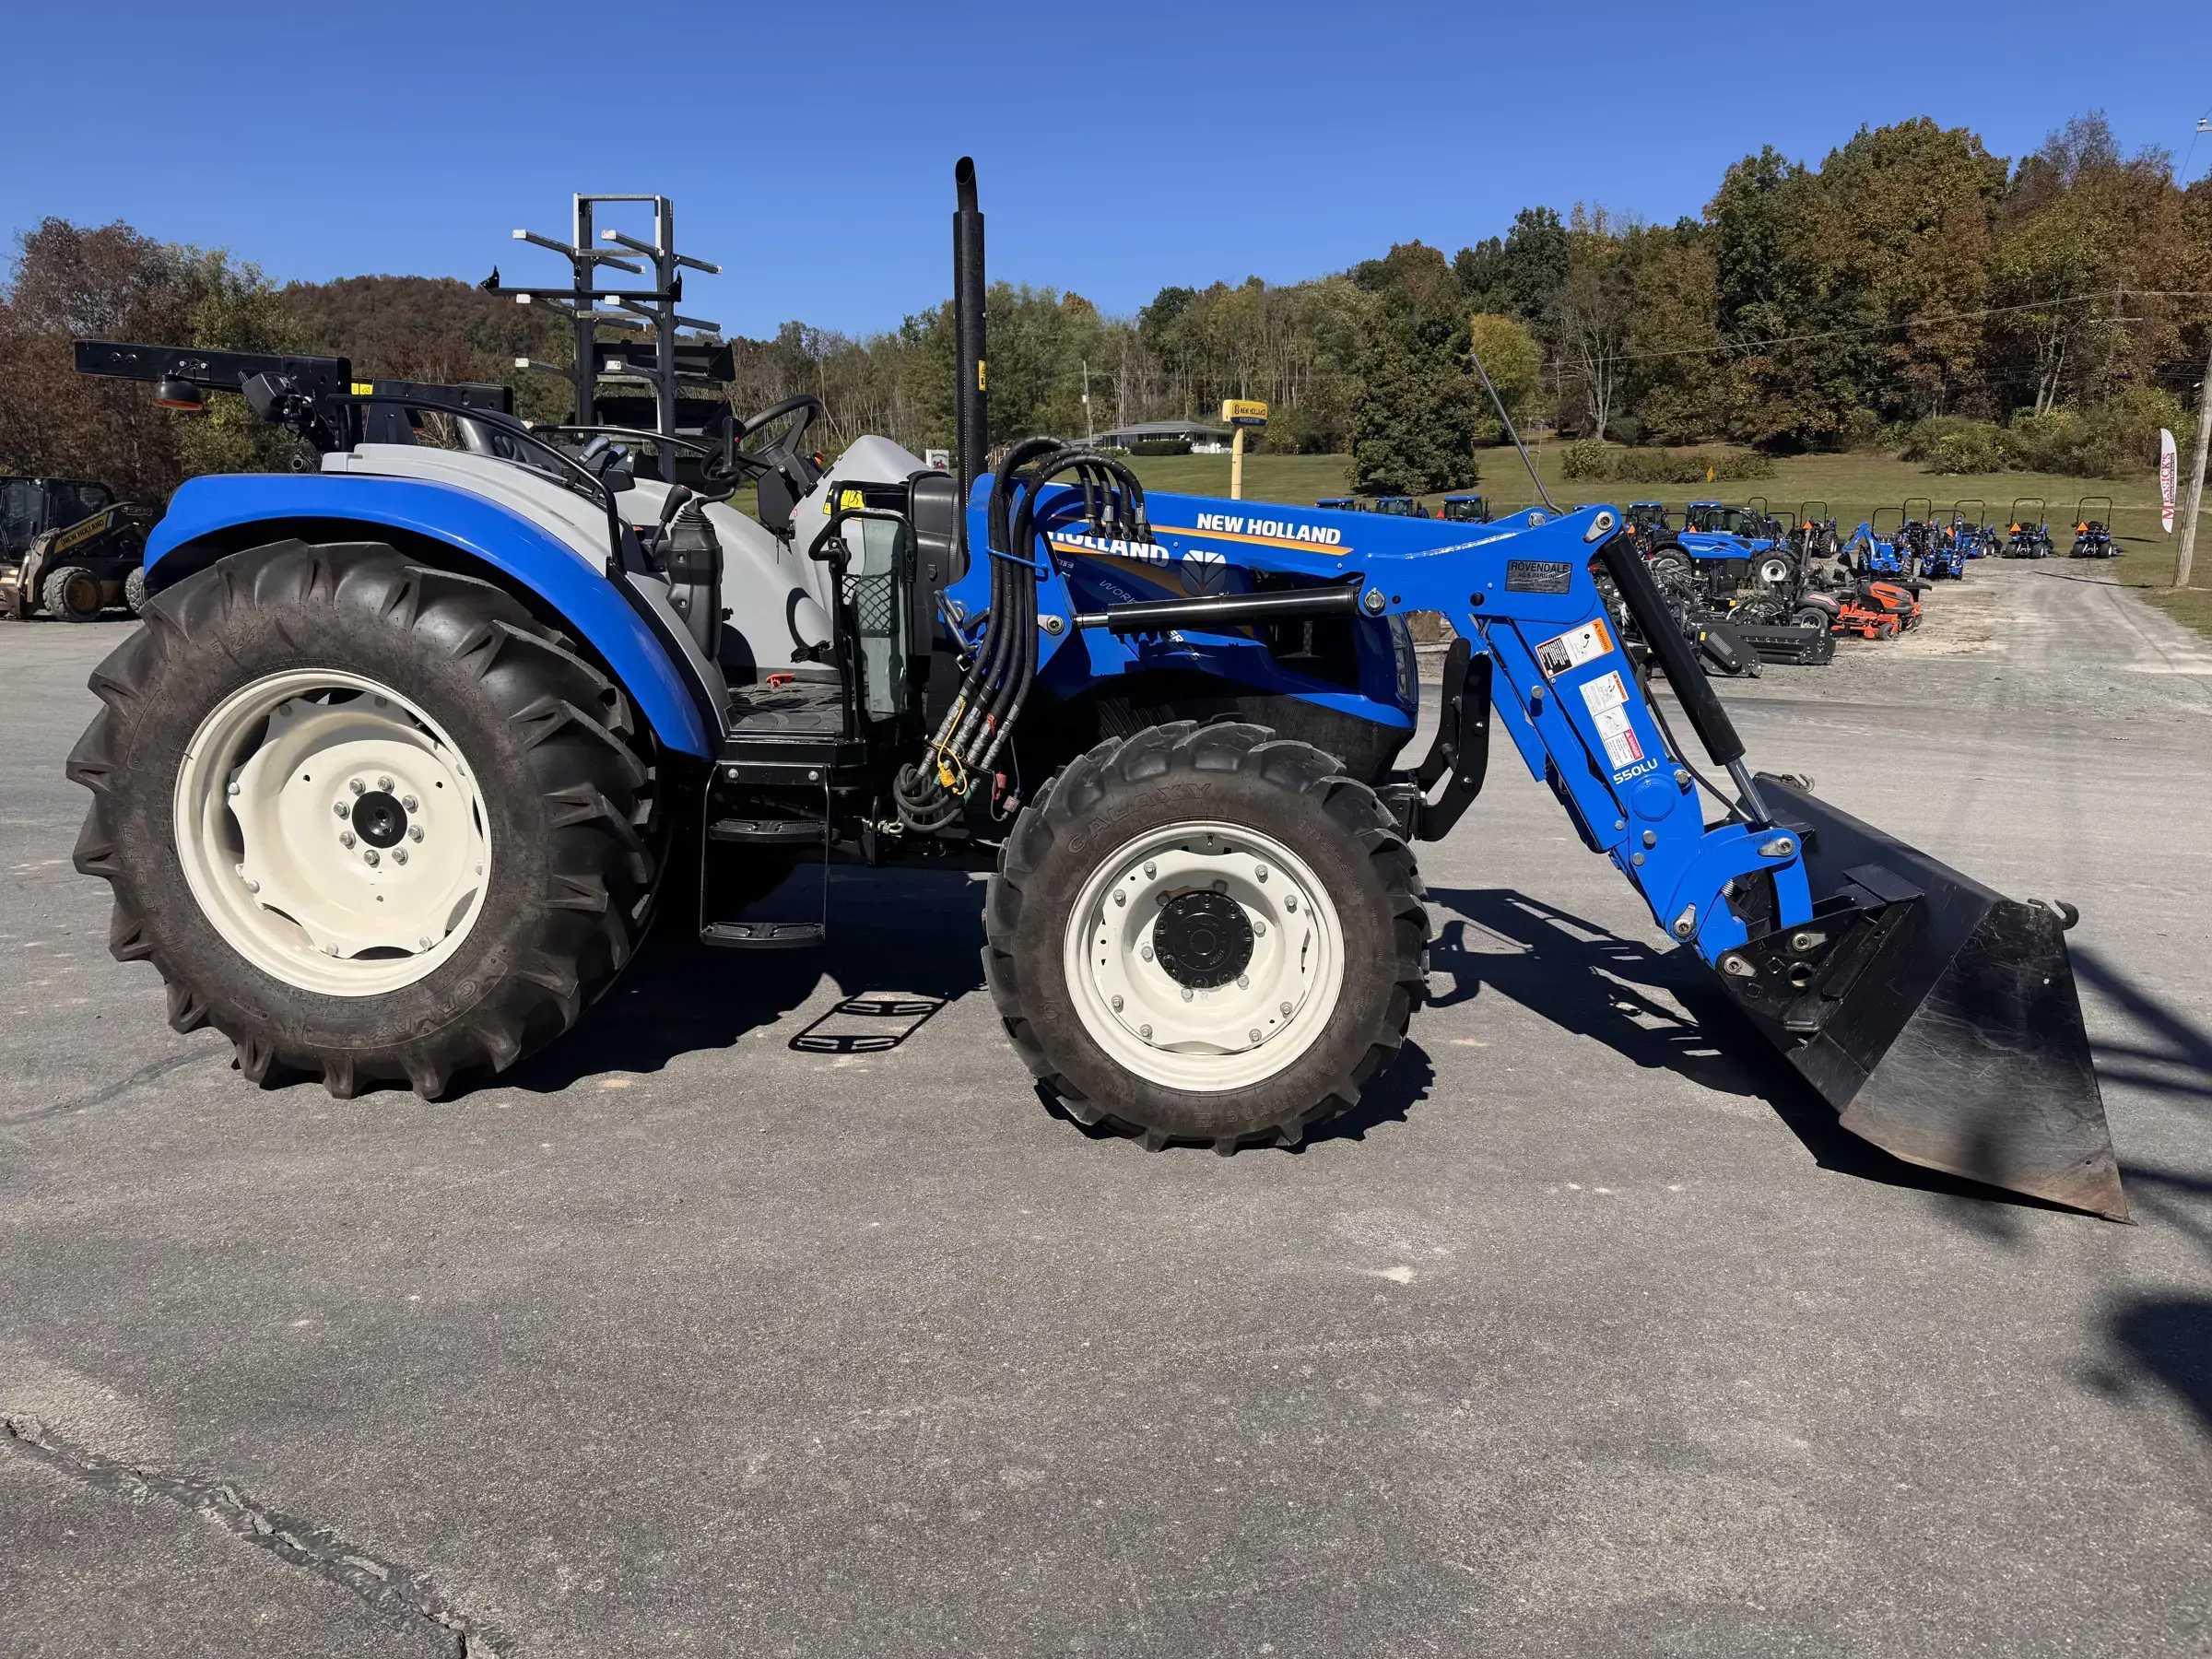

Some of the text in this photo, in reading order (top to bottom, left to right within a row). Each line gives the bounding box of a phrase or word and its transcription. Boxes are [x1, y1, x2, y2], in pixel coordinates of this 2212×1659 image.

[62, 519, 105, 546] NEW HOLLAND
[1196, 512, 1341, 546] NEW HOLLAND
[1511, 561, 1569, 573] ROVENDALE
[1613, 759, 1658, 785] 550LU
[1066, 782, 1213, 855] GALAXY
